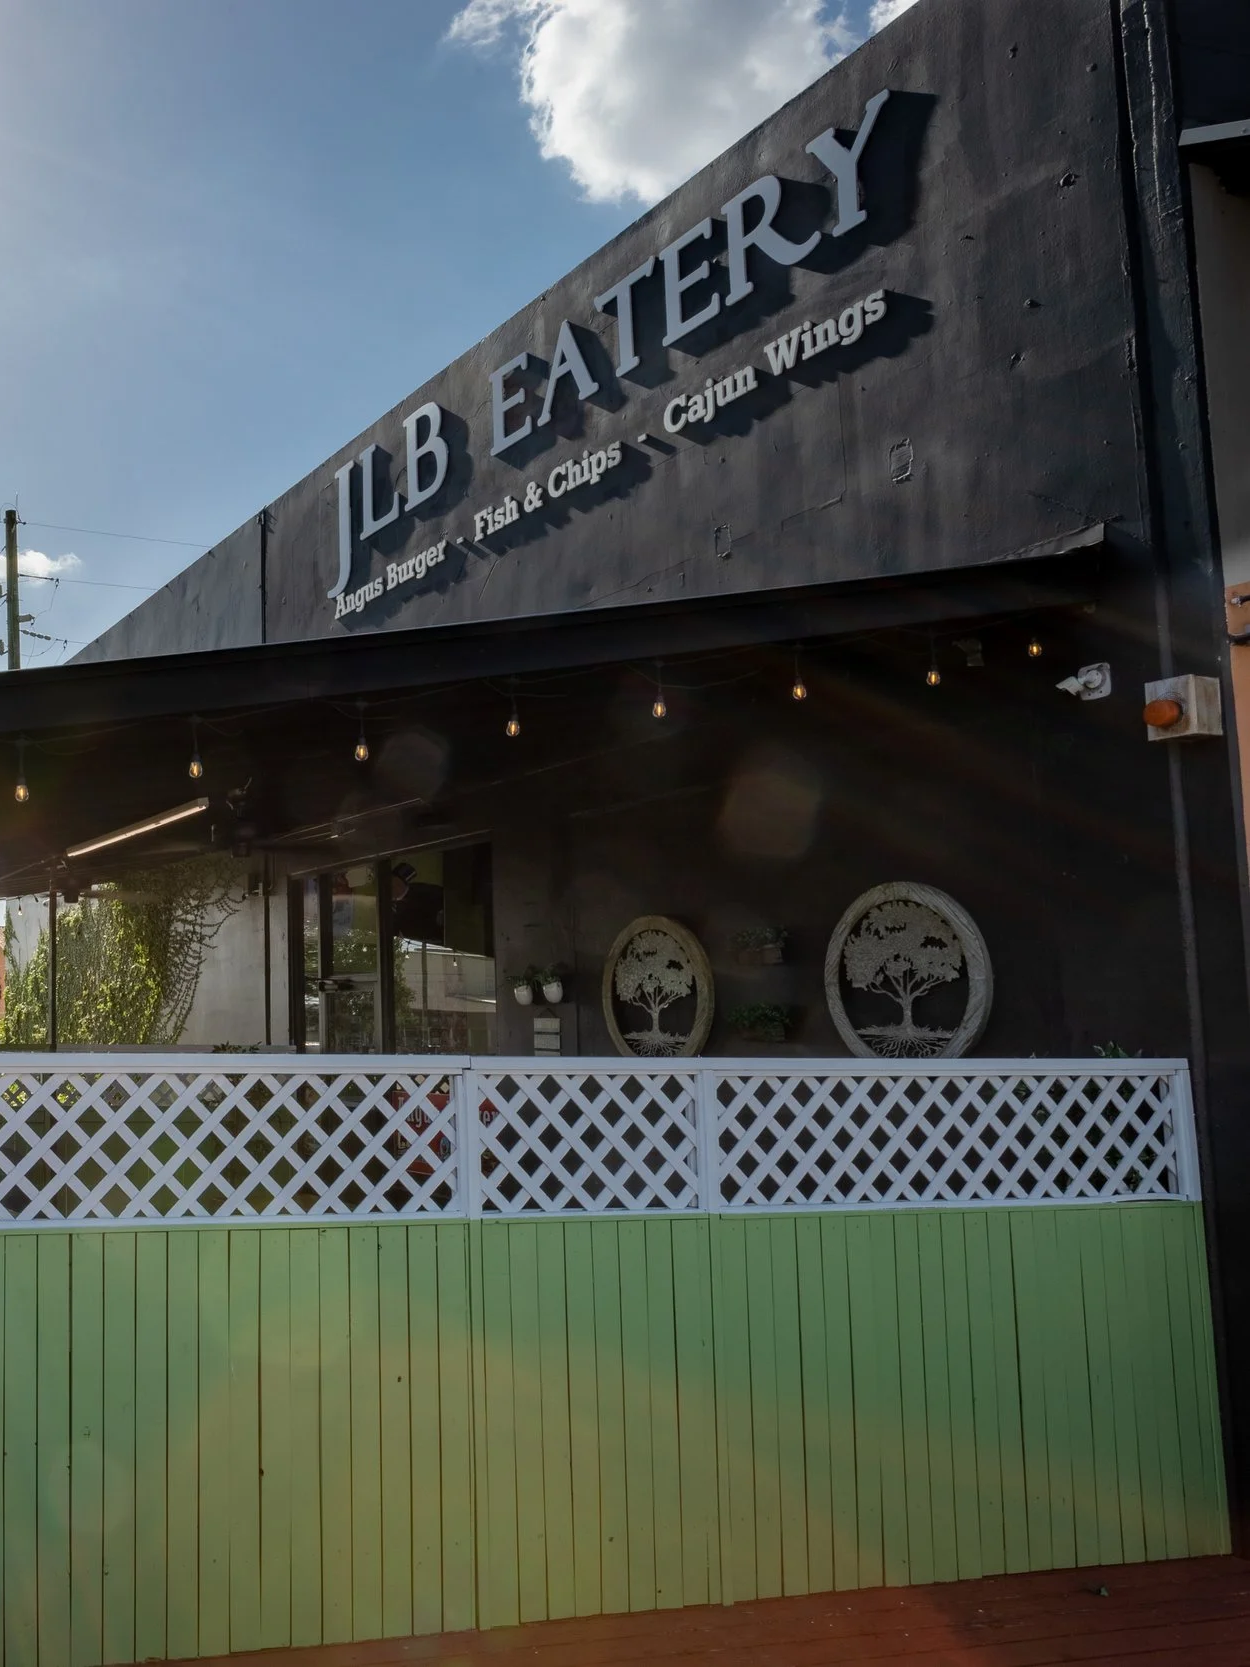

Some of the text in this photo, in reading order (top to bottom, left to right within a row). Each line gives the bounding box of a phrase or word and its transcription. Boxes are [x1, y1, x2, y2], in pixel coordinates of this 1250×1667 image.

[327, 88, 891, 599] JLB EATERY
[334, 576, 384, 620] Angus
[386, 540, 448, 591] Burger
[473, 495, 520, 542] Fish
[523, 481, 543, 513] &
[547, 441, 622, 498] Chips
[663, 365, 758, 433] Cajun
[763, 289, 887, 377] Wings
